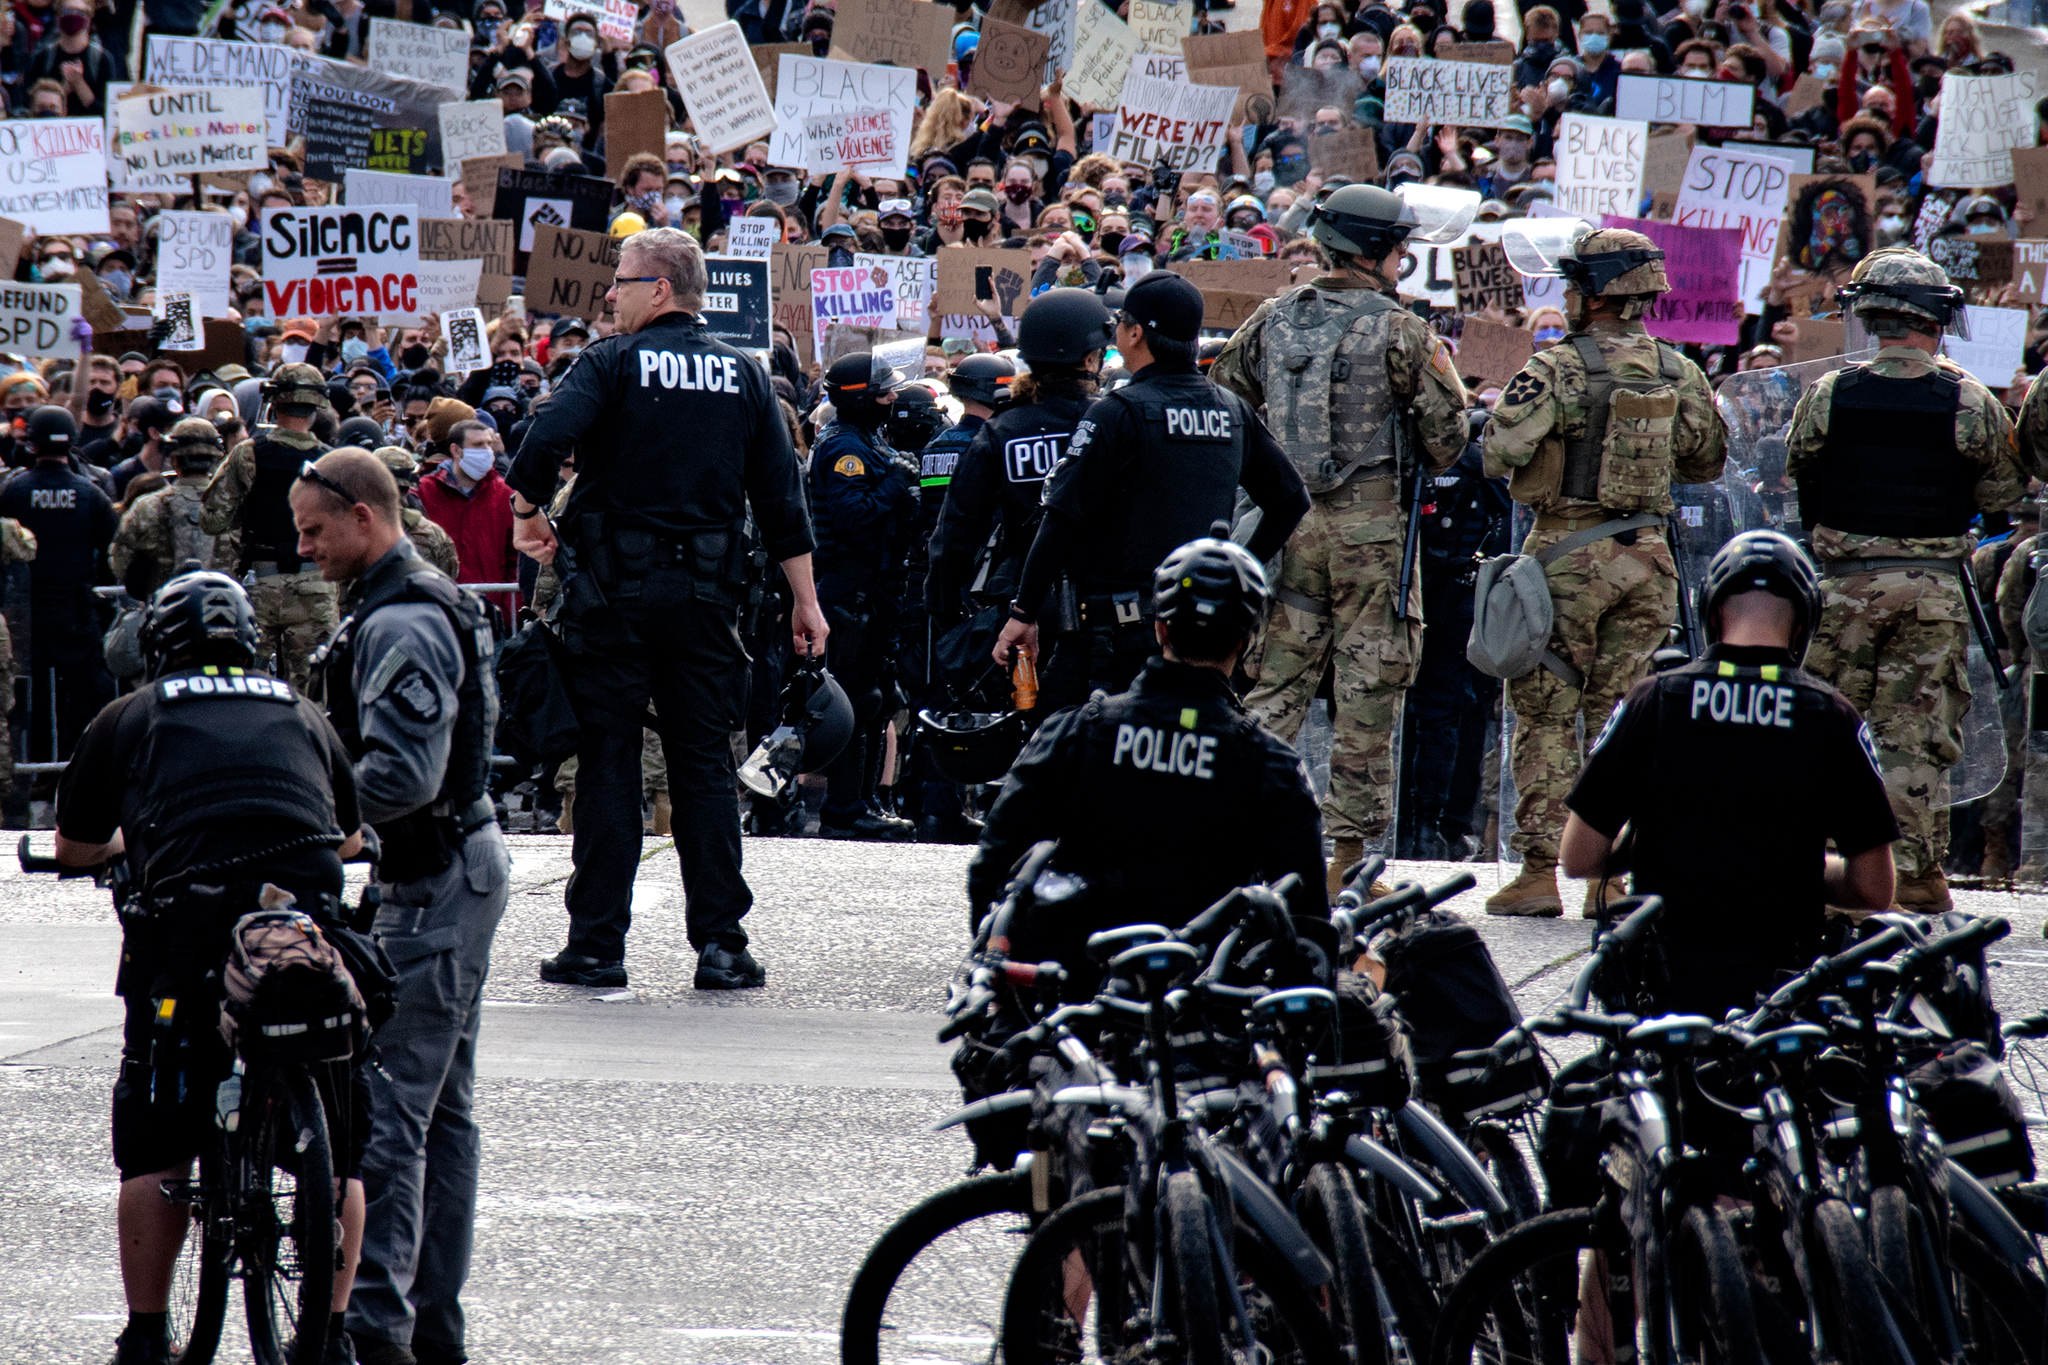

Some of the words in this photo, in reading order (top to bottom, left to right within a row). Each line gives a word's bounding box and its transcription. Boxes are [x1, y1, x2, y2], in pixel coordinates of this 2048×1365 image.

[1132, 3, 1184, 27] BLACK
[1140, 27, 1178, 48] LIVES
[150, 38, 186, 73] WE
[193, 42, 288, 80] DEMAND
[1091, 42, 1126, 87] Police!
[692, 95, 716, 110] WILL
[716, 81, 738, 101] BURN
[739, 74, 750, 87] IT
[700, 71, 717, 86] THE
[793, 61, 908, 110] BLACK
[1388, 66, 1443, 92] BLACK
[1454, 70, 1509, 95] LIVES
[2003, 71, 2035, 102] IS
[313, 80, 346, 102] YOU
[350, 91, 392, 112] LOOK
[1125, 75, 1177, 116] HOW
[1175, 85, 1238, 121] MANY
[1408, 92, 1497, 119] MATTER
[1655, 80, 1726, 122] BLM
[698, 106, 727, 126] DOWN
[727, 107, 765, 130] WARMTH
[806, 121, 843, 141] White
[845, 111, 890, 135] SILENCE
[31, 124, 103, 156] KILLING
[121, 129, 159, 145] Black
[163, 121, 201, 138] Lives
[207, 120, 262, 136] Matter
[1568, 122, 1640, 162] BLACK
[126, 154, 148, 176] No
[154, 147, 197, 168] Lives
[201, 142, 259, 166] Matter
[820, 146, 835, 162] is
[836, 133, 894, 160] VIOLENCE
[1112, 131, 1217, 171] FILMED?
[1573, 156, 1636, 184] LIVES
[1689, 155, 1785, 205] STOP
[160, 215, 232, 247] DEFUND
[265, 212, 411, 259] Silence
[731, 236, 770, 248] KILLING
[739, 223, 765, 235] STOP
[1229, 237, 1253, 249] STOP
[173, 246, 216, 270] SPD
[553, 231, 584, 260] NO
[443, 273, 466, 284] CAN
[550, 278, 581, 307] NO
[712, 271, 752, 287] LIVES
[811, 268, 869, 293] STOP
[1456, 267, 1515, 289] LIVES
[2018, 270, 2036, 291] A
[264, 272, 418, 317] Violence
[814, 289, 893, 317] KILLING
[1458, 283, 1526, 312] MATTER
[448, 311, 460, 319] WE
[461, 309, 475, 318] CAN
[817, 315, 883, 343] BACK
[639, 349, 740, 394] POLICE
[1165, 407, 1232, 438] POLICE
[921, 453, 934, 477] STATE
[30, 488, 77, 509] POLICE
[162, 675, 292, 700] POLICE
[1690, 679, 1794, 727] POLICE
[1113, 724, 1218, 779] POLICE
